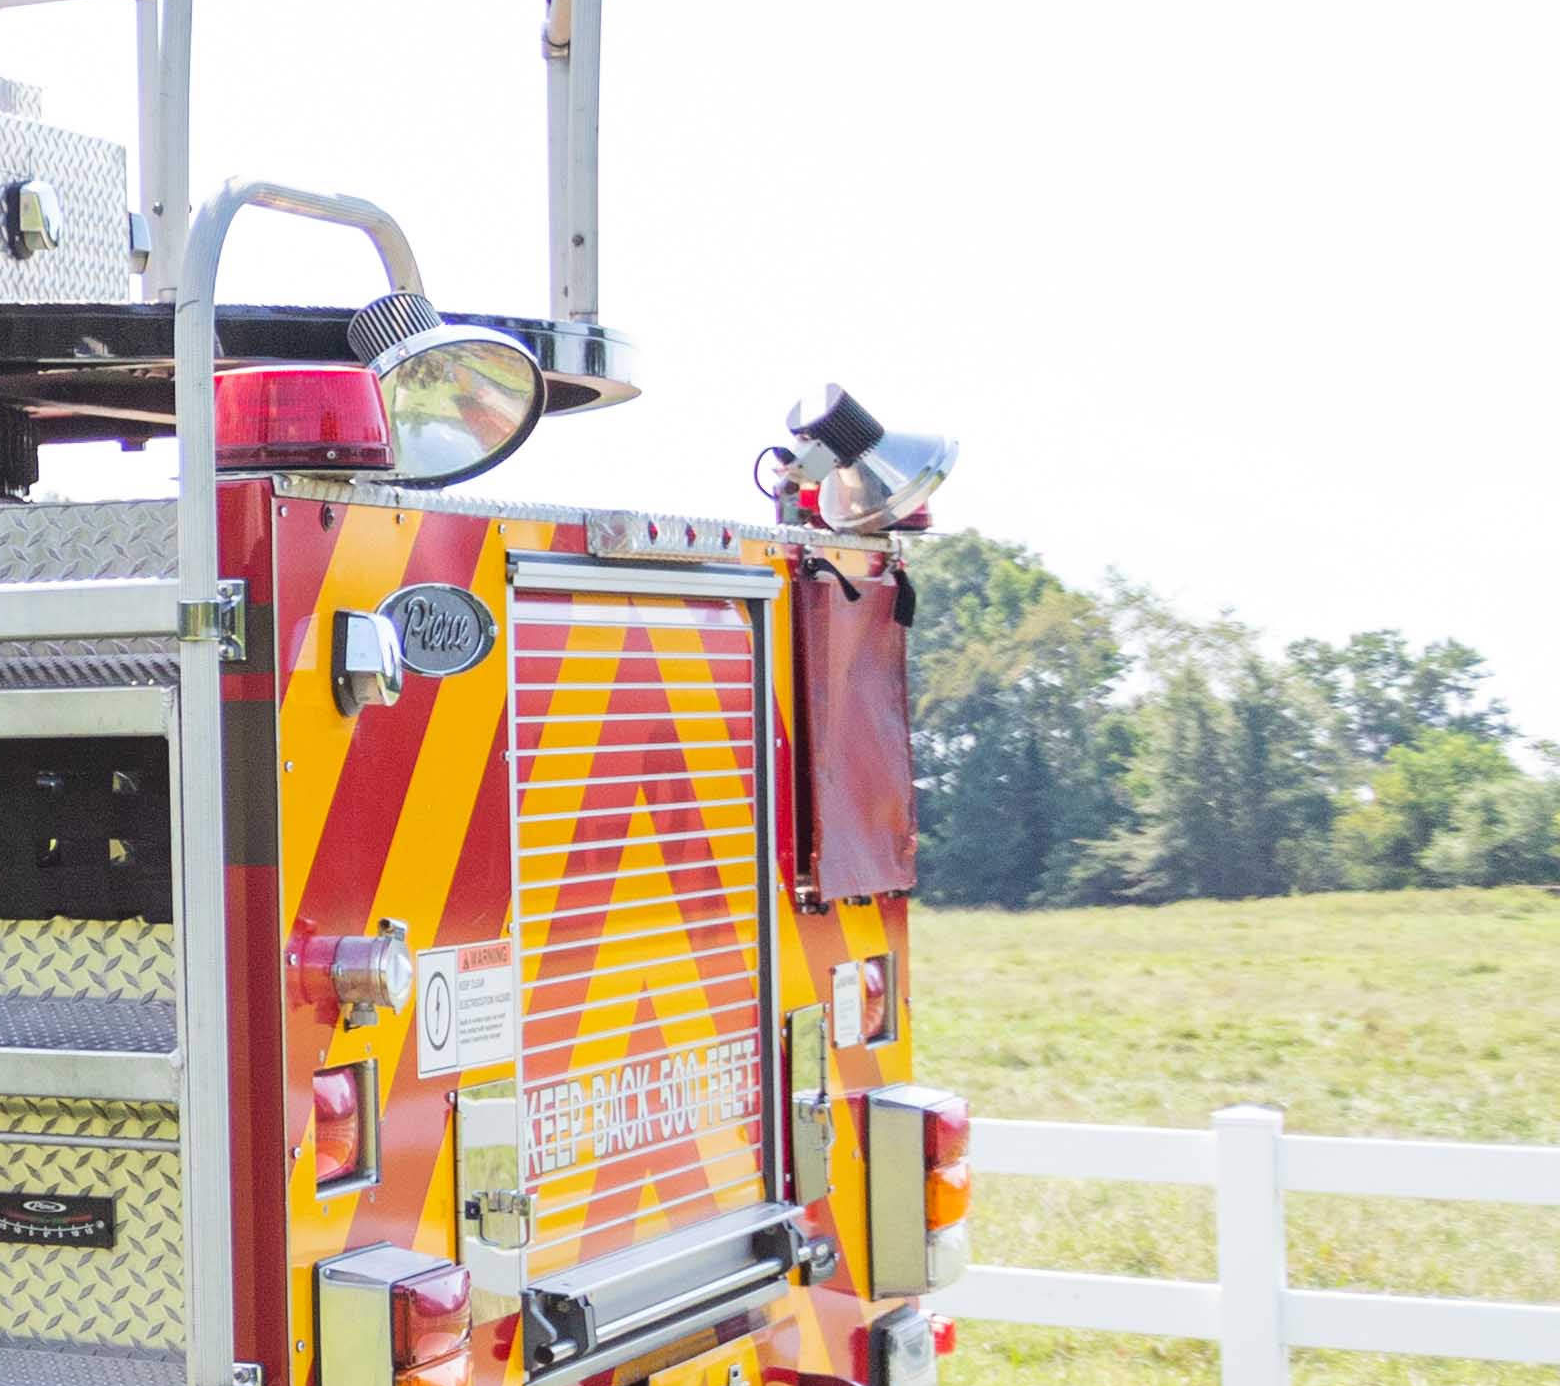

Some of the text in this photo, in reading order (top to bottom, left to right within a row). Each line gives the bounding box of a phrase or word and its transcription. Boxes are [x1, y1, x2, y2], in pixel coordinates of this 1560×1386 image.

[403, 596, 471, 656] Pierce
[471, 946, 508, 966] WARNING
[523, 1038, 756, 1179] KEEP BACK 500 FEET
